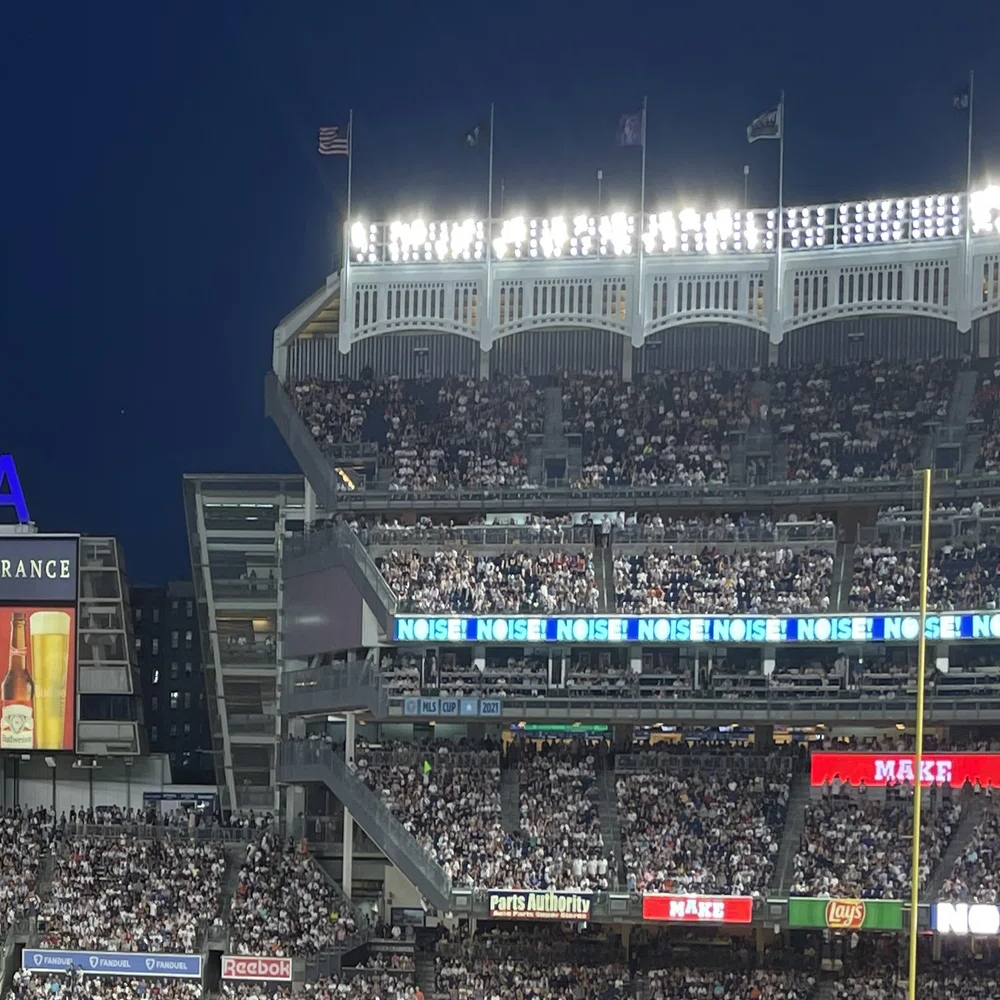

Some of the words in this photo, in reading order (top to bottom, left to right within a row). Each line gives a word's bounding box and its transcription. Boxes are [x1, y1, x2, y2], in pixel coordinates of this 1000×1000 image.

[399, 618, 467, 641] NOISE!
[477, 618, 547, 641] NOISE!
[557, 618, 629, 641] NOISE!
[638, 618, 711, 641] NOISE!
[713, 618, 788, 641] NOISE!
[797, 617, 874, 641] NOISE!
[884, 615, 962, 640] NOSE!
[422, 702, 437, 713] MLS
[442, 702, 457, 713] CUP
[482, 702, 499, 714] 2021
[874, 759, 953, 782] MAKE
[490, 894, 526, 911] Parts
[527, 892, 590, 913] Authority
[669, 894, 724, 918] MAKE
[829, 902, 862, 925] Lay's
[100, 959, 131, 968] FANDUEL
[156, 961, 188, 970] FANDUEL
[224, 959, 290, 976] Reebok
